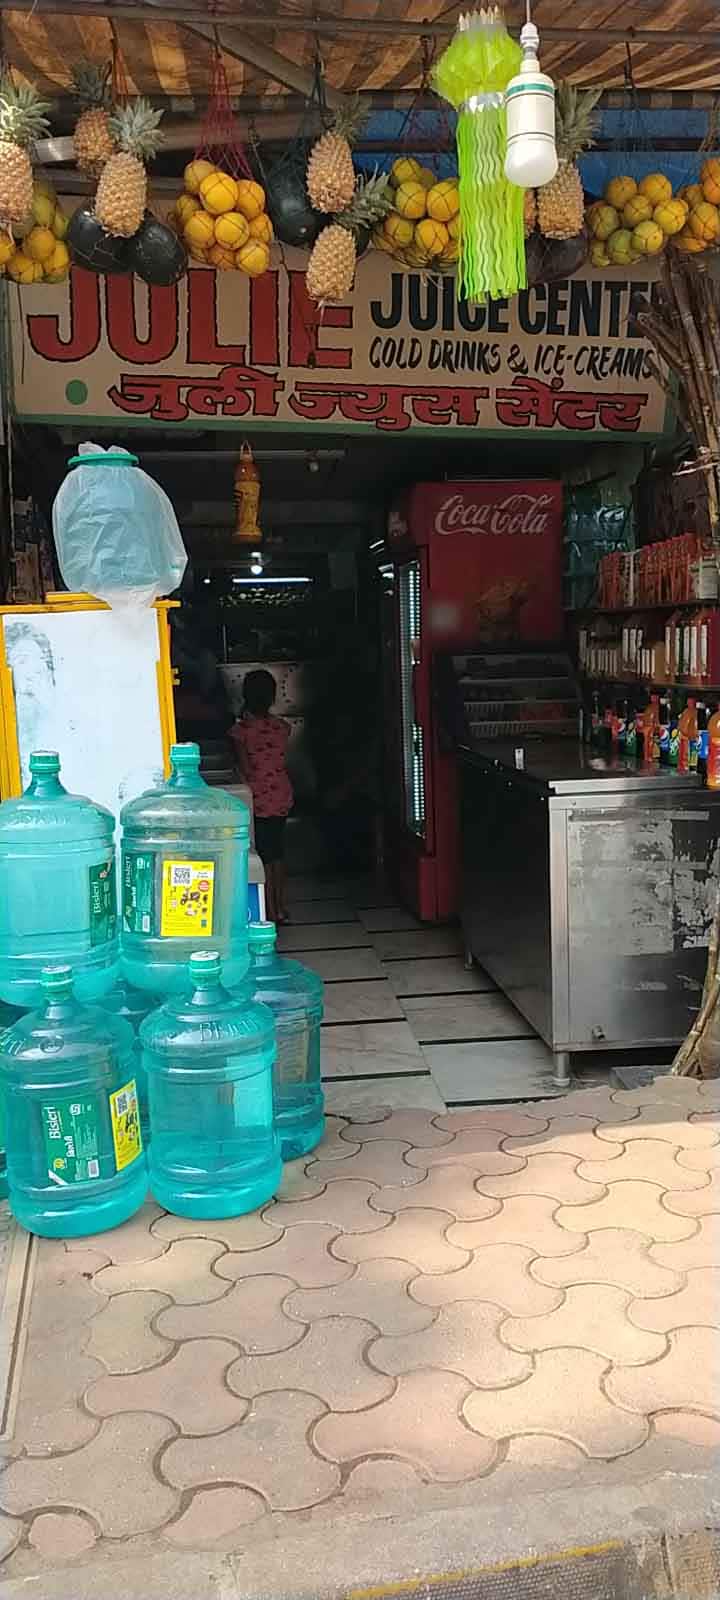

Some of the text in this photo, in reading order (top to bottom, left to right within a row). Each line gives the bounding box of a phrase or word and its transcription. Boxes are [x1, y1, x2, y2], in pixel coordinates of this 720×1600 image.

[27, 265, 352, 368] JULIE
[370, 273, 657, 339] JUICE CENTE
[369, 336, 654, 381] COLD DRINKS & ICE-CREAMS
[107, 365, 649, 432] जुली ज्युस सेंटर
